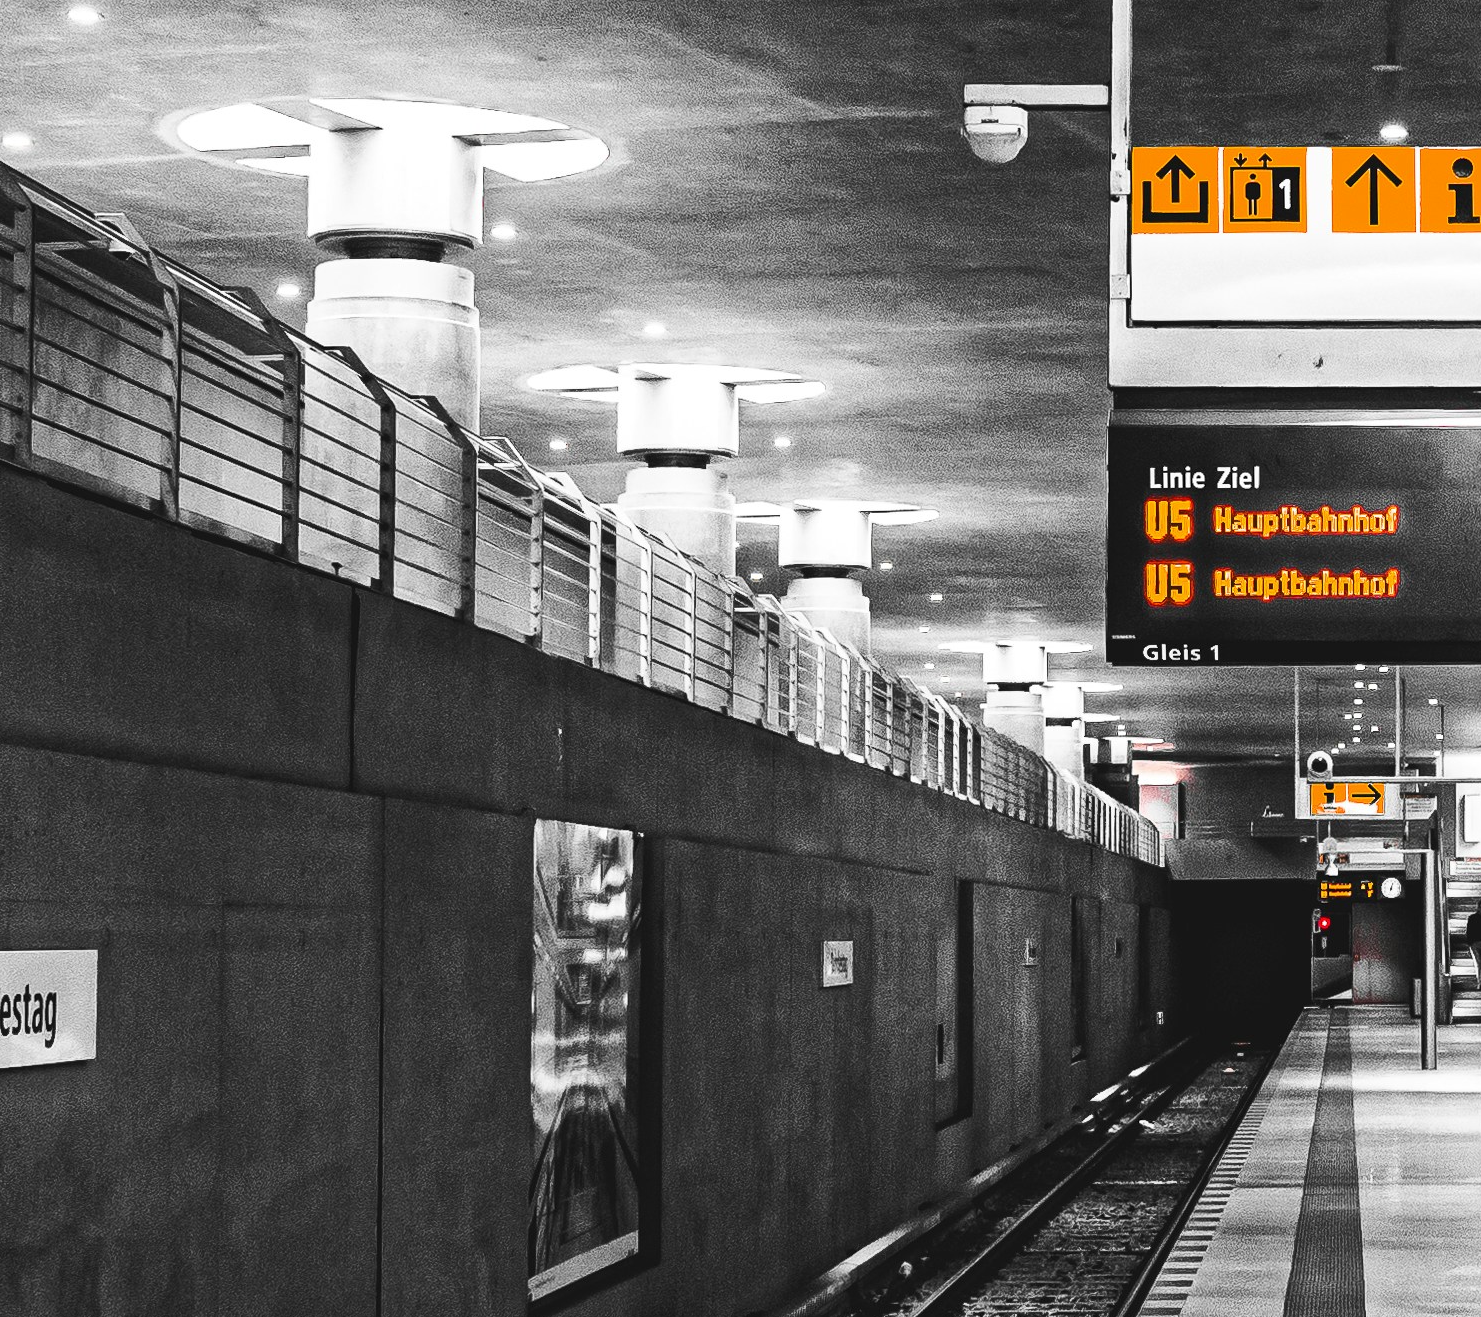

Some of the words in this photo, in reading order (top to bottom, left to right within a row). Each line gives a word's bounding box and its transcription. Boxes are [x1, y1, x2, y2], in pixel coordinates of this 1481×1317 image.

[1278, 178, 1292, 210] 1
[1149, 466, 1206, 489] Linie
[1217, 465, 1261, 489] Ziel
[1145, 497, 1194, 542] U5
[1213, 505, 1399, 537] Hauptbahnhof
[1145, 560, 1194, 605] U5
[1213, 567, 1399, 601] Hauptbahnhof
[1142, 644, 1201, 661] Gleis
[1209, 644, 1220, 661] 1
